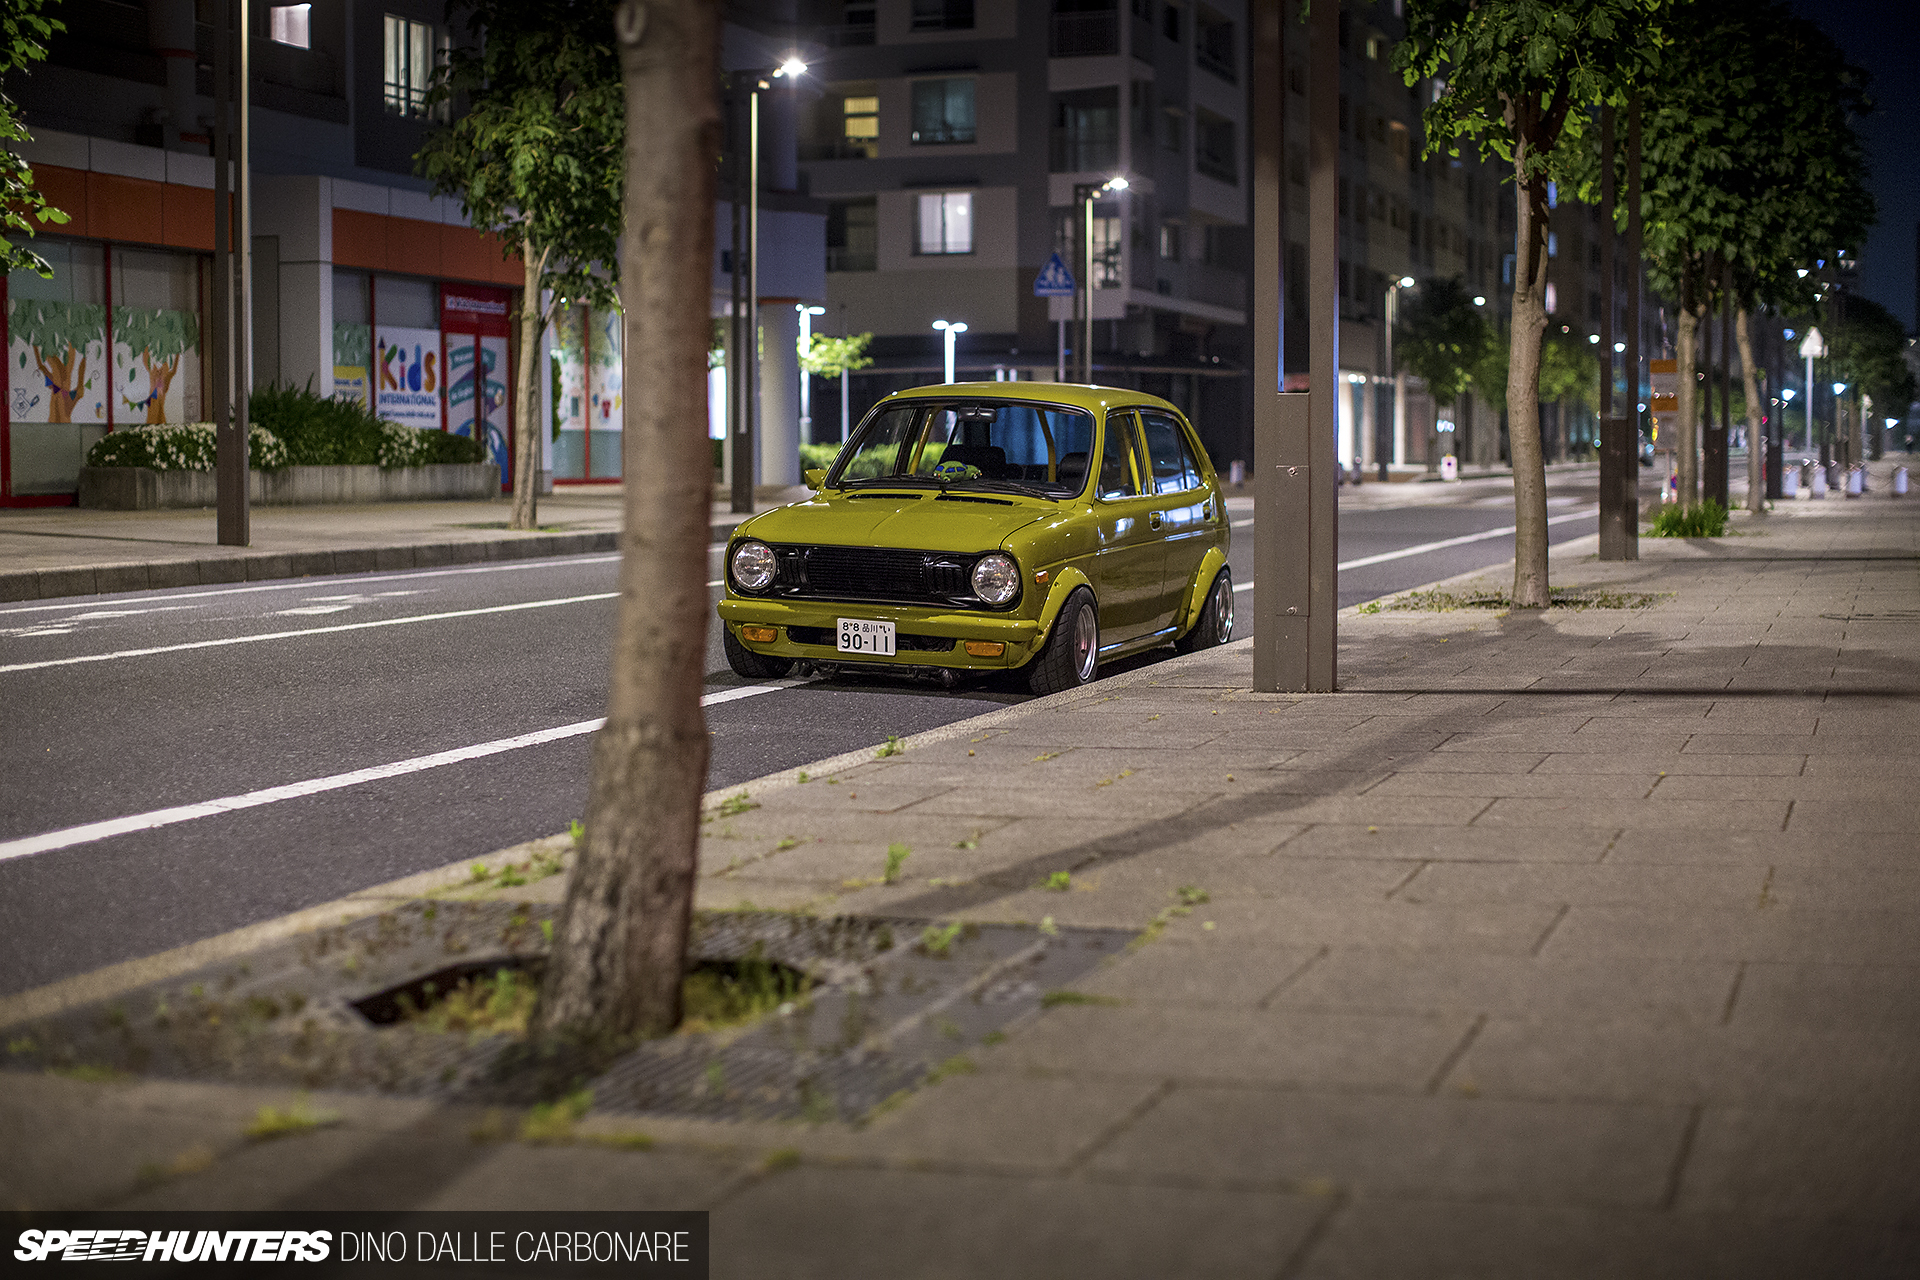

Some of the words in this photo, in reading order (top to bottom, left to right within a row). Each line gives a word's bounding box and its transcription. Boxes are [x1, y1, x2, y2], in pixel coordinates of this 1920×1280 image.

[378, 336, 437, 393] Kids
[378, 393, 437, 407] INTERNATIONAL
[841, 633, 889, 652] 90-11
